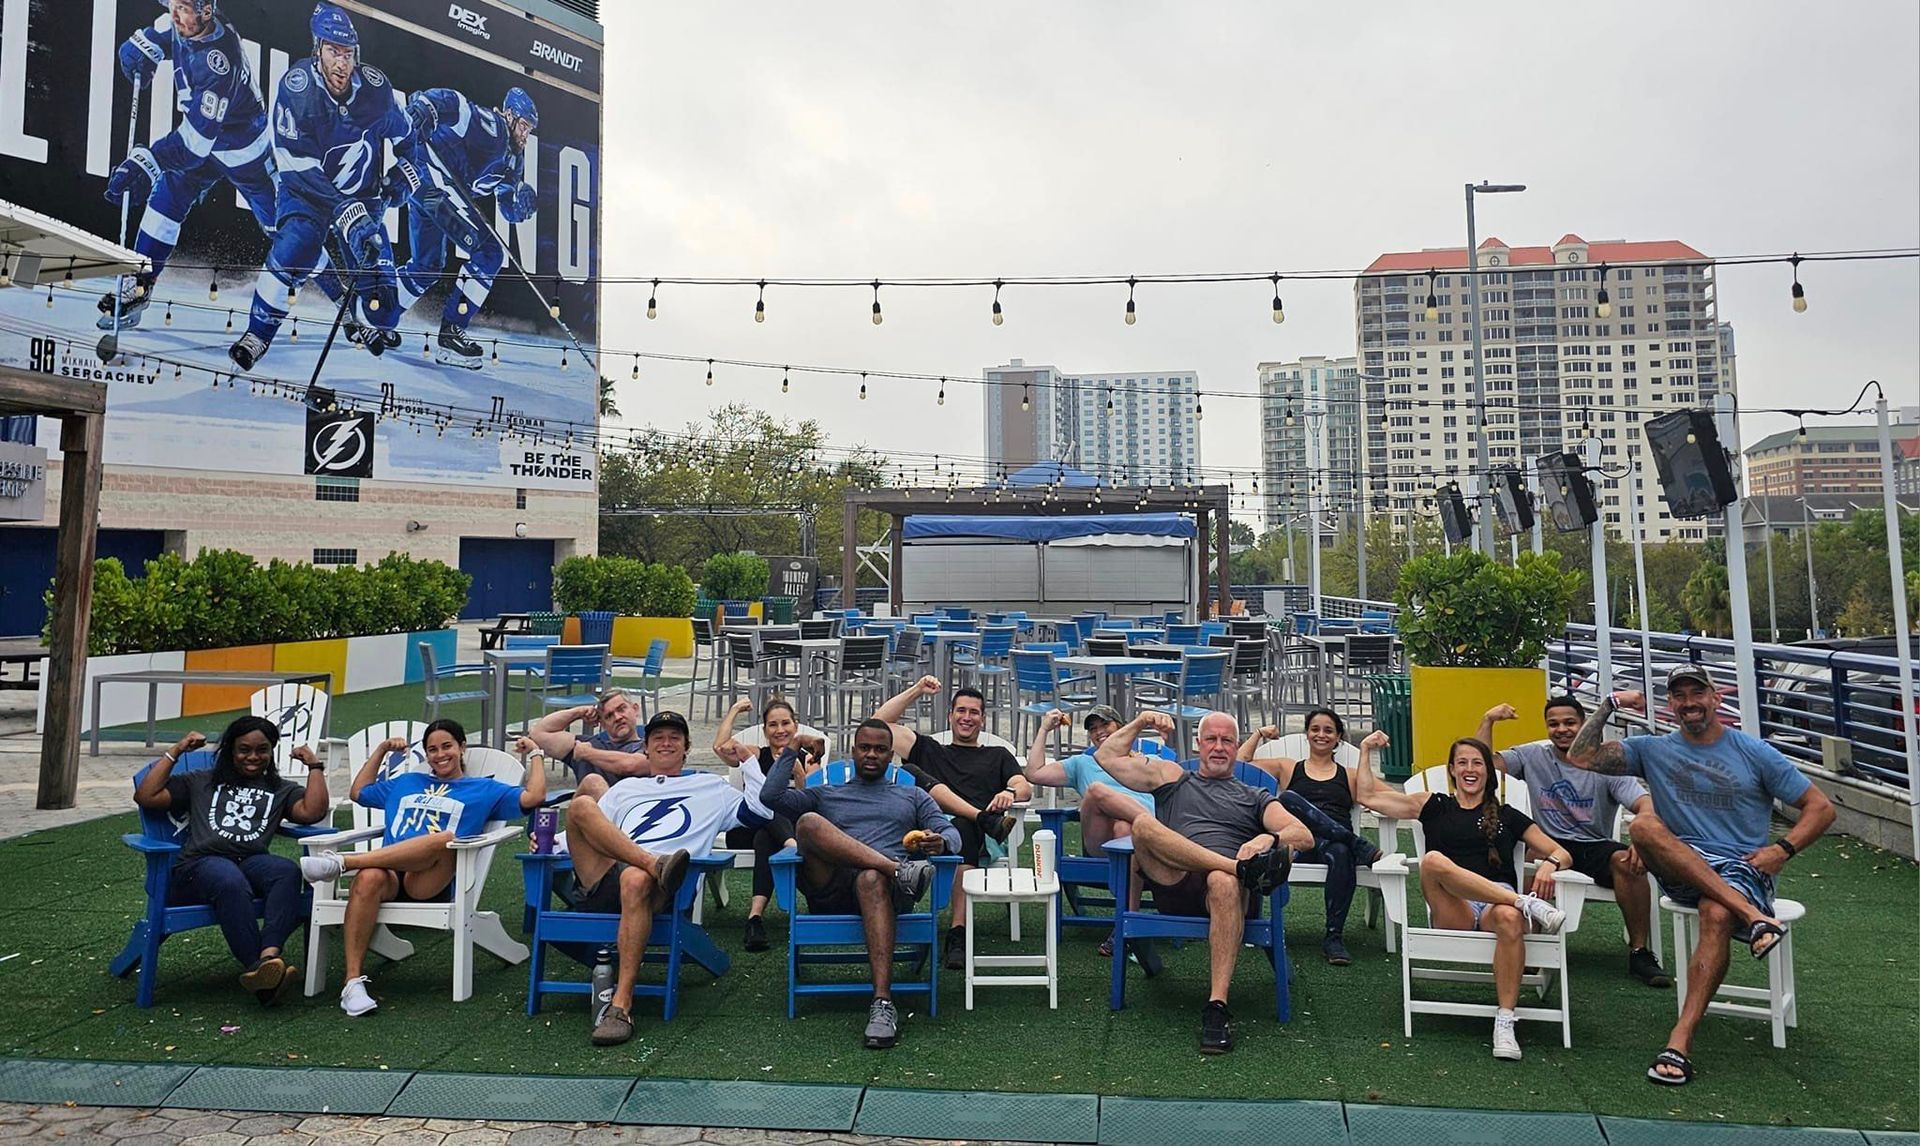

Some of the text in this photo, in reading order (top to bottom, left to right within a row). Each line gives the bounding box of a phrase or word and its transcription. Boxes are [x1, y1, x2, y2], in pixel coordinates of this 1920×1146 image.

[448, 3, 488, 31] DEX
[529, 39, 583, 73] BRANDT
[277, 102, 299, 141] 21
[30, 337, 55, 374] 98
[60, 366, 156, 385] SERGACHEV
[491, 396, 504, 424] 77
[510, 464, 592, 480] THUNDER
[524, 451, 581, 467] BE THE
